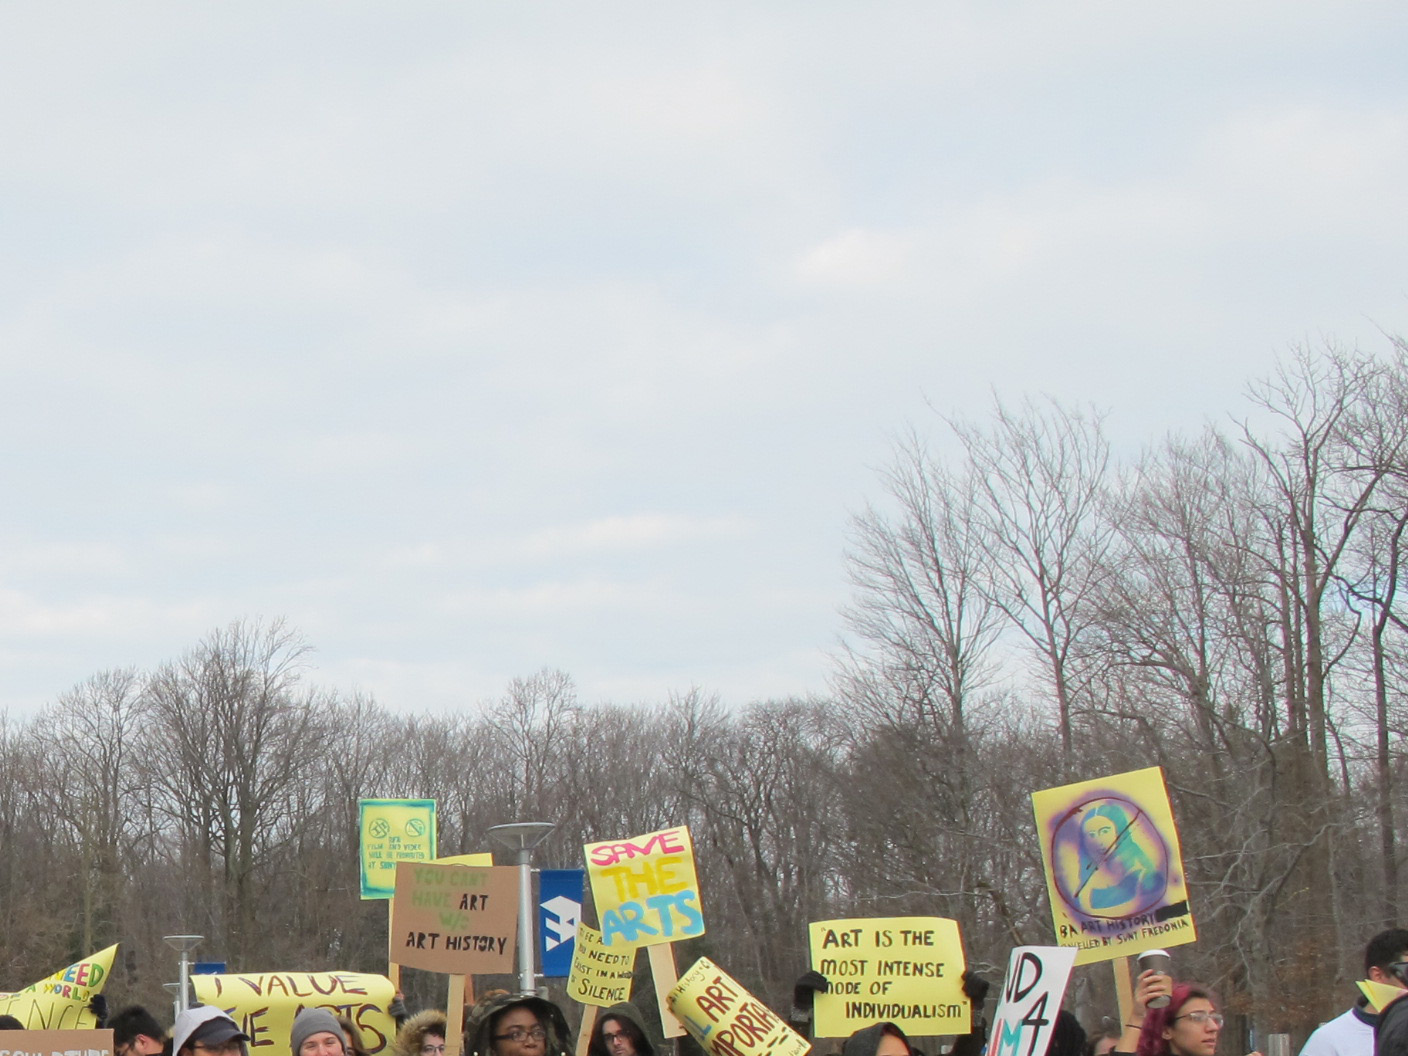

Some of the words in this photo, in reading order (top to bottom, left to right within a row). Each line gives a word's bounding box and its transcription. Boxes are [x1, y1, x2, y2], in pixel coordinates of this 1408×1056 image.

[590, 831, 685, 866] SAVE
[415, 868, 444, 884] YOU
[450, 870, 489, 886] CANT
[600, 856, 689, 902] THE
[412, 889, 451, 908] HAVE
[459, 893, 489, 911] ART
[602, 889, 703, 946] ARTS
[1080, 920, 1103, 935] ART
[1107, 912, 1155, 931] HISTORY
[1141, 919, 1190, 938] FREDONIA
[406, 931, 440, 950] ART
[445, 935, 507, 955] HISTORY
[875, 930, 893, 947] IS
[899, 930, 935, 946] THE
[588, 950, 619, 964] NEED
[820, 959, 868, 976] MOST
[877, 960, 945, 977] INTENSE
[214, 977, 223, 998] I
[238, 975, 369, 998] VALUE
[578, 978, 625, 1001] SILENCE
[869, 981, 892, 995] OF
[695, 976, 739, 1023] ART
